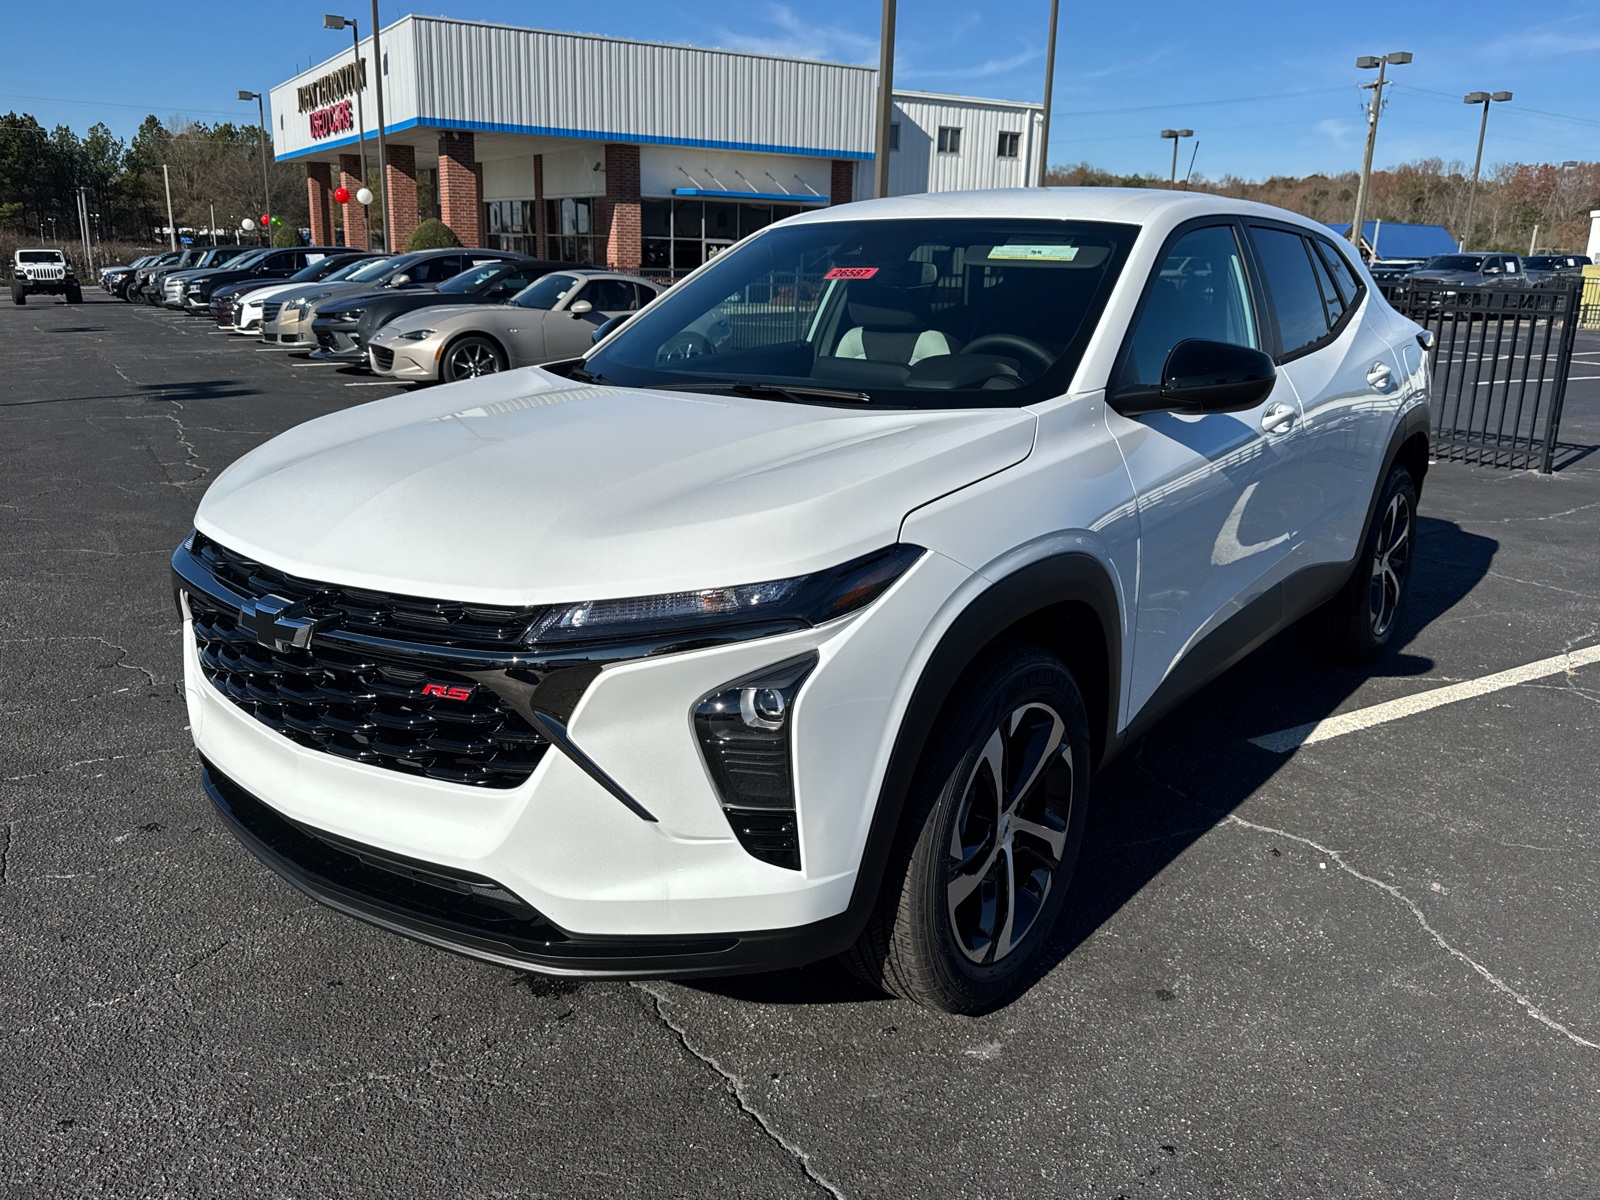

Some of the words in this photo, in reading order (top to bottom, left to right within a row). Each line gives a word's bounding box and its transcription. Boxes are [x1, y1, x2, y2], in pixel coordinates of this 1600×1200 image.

[297, 82, 318, 113] JOHN
[309, 109, 330, 139] USED
[328, 100, 353, 132] CARS
[831, 269, 871, 277] 26587
[422, 683, 471, 701] RS
